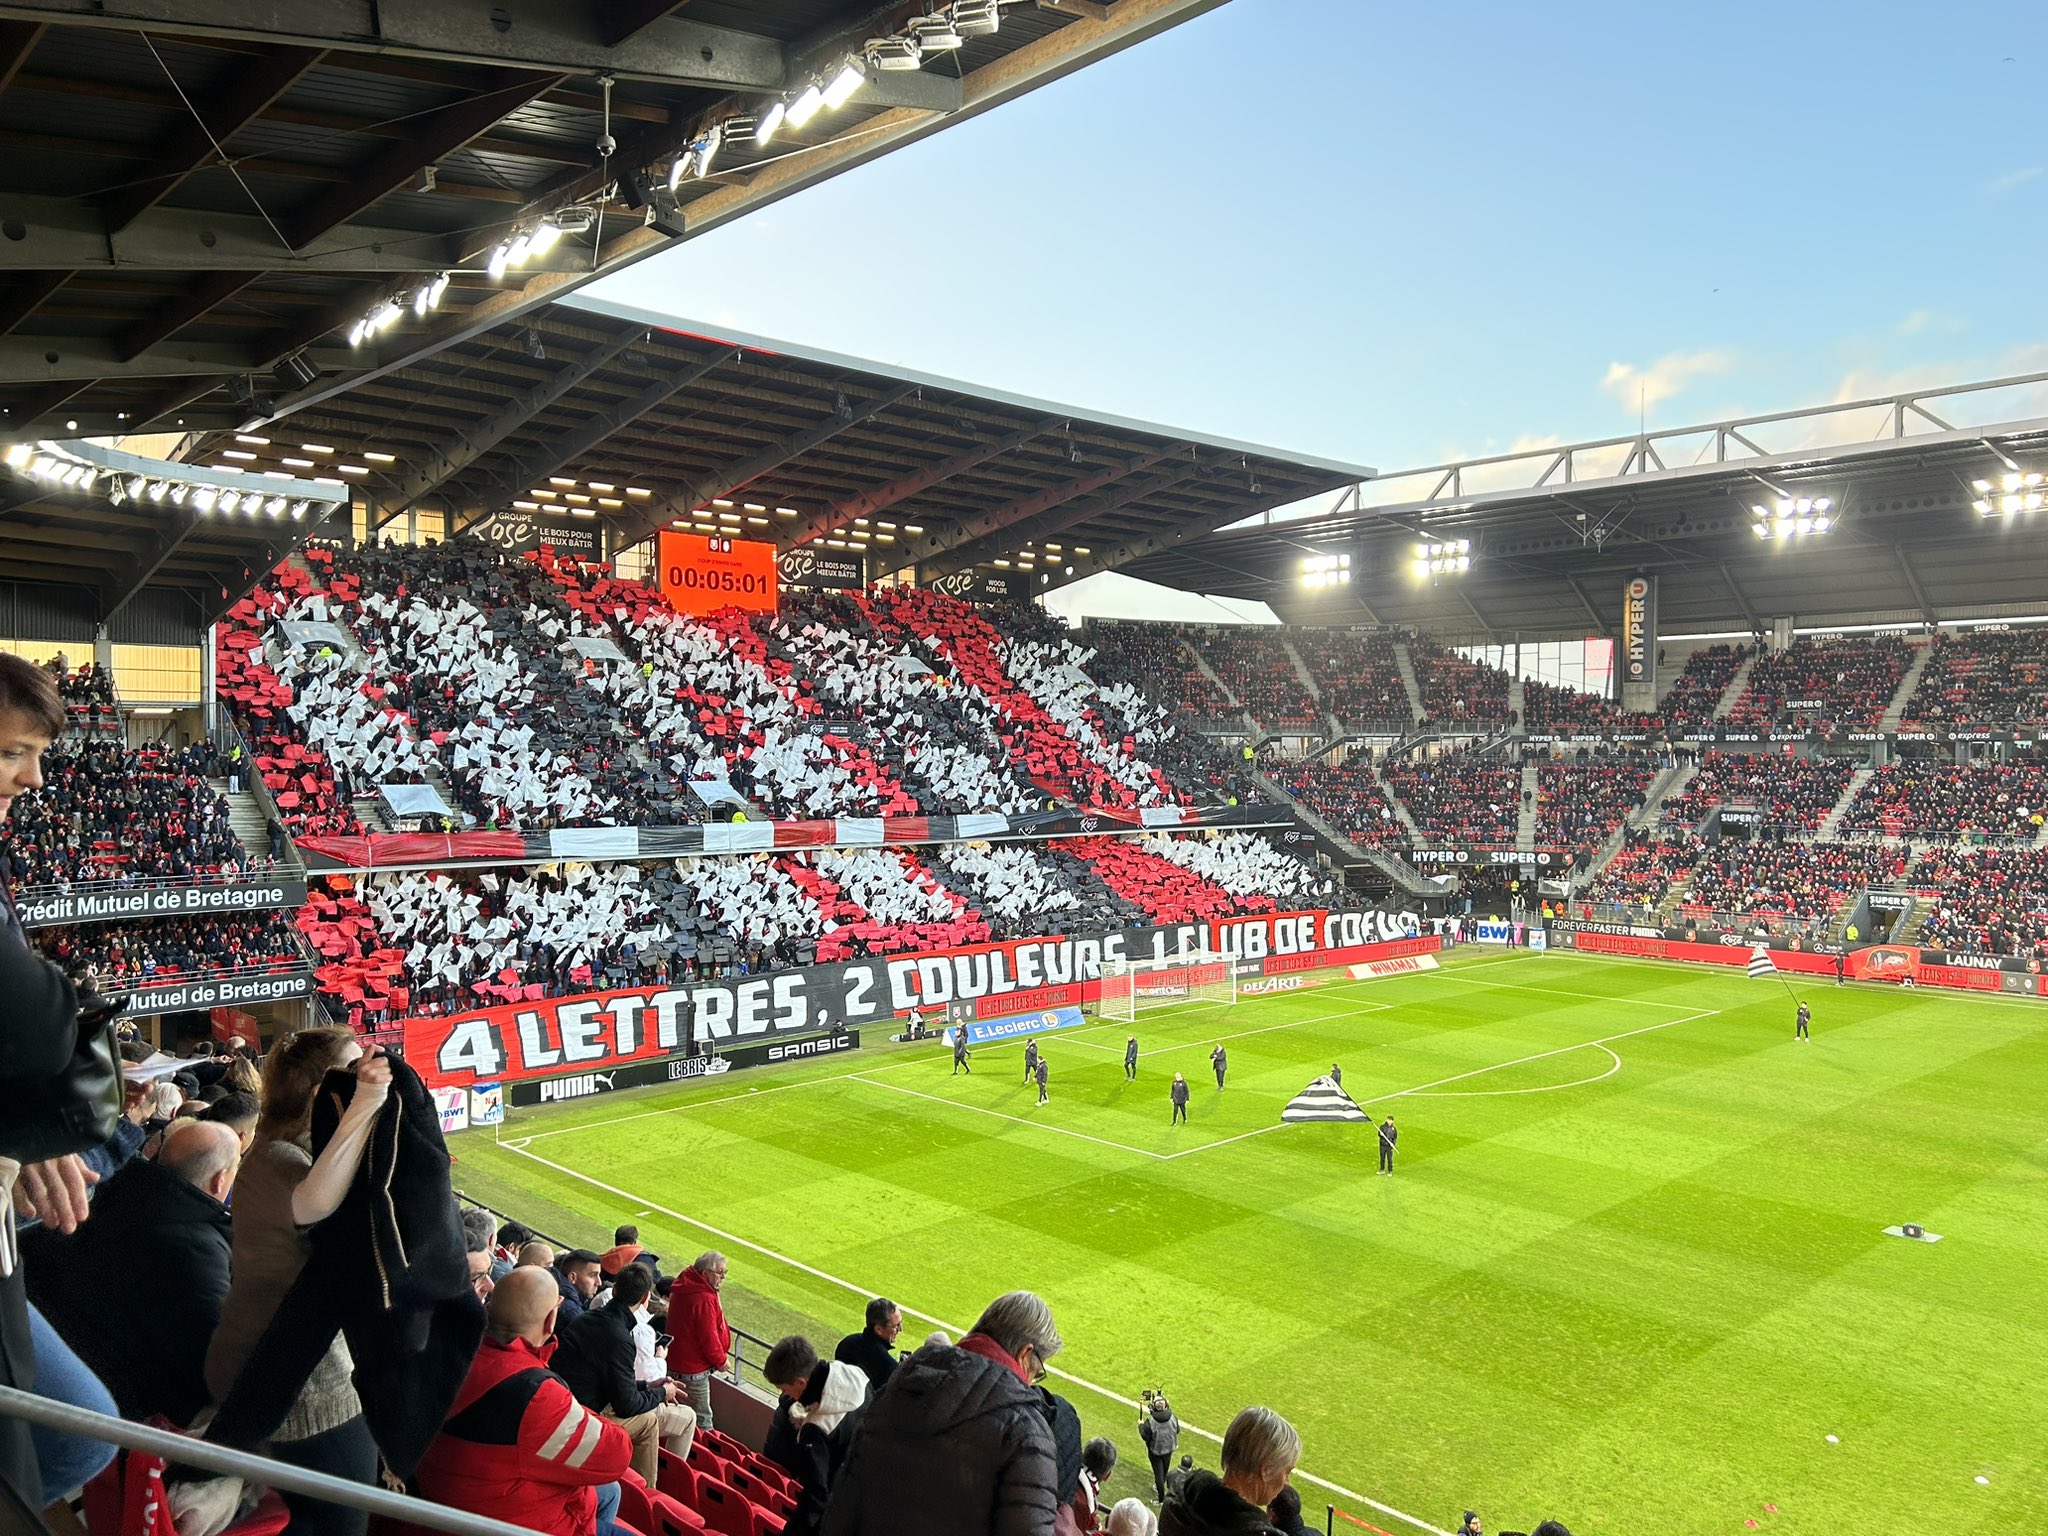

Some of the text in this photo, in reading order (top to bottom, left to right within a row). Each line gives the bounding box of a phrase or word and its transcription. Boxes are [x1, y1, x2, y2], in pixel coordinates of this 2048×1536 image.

[498, 512, 532, 523] GROUPE
[540, 528, 593, 540] LE BOIS POUR
[540, 536, 593, 548] MIEUX BÂTIR
[838, 569, 856, 578] BÂTIR
[840, 563, 856, 571] POUR
[669, 566, 767, 594] 00:05:01
[988, 579, 1005, 587] WOOD
[1630, 600, 1644, 659] HYPER
[1786, 700, 1814, 708] SUPER
[1958, 732, 1990, 740] express
[1721, 814, 1752, 822] SUPER
[1080, 817, 1098, 834] Rose
[1413, 852, 1454, 862] HYPER
[1491, 852, 1536, 863] SUPER
[16, 887, 284, 922] Crédit Mutuel de Bretagne
[1870, 896, 1900, 905] SUPER
[1478, 926, 1508, 939] BW
[1719, 934, 1743, 947] Rose
[1368, 958, 1422, 975] WINAMAX
[1946, 954, 2002, 969] LAUNAY
[1923, 969, 1941, 982] EATS
[1964, 970, 1998, 987] JOURNÉE
[1243, 976, 1304, 994] DEL ARTE
[122, 988, 186, 1010] Mutuel
[191, 987, 215, 1004] de
[220, 978, 306, 1000] Bretagne
[440, 1021, 500, 1074] 4
[842, 966, 876, 1016] 2
[888, 934, 1126, 1010] COULEURS
[1152, 931, 1168, 970] 1
[1178, 920, 1268, 966] CLUB
[1274, 915, 1316, 955] DE
[981, 1001, 997, 1015] LIGUE
[1001, 998, 1016, 1013] UBER
[1017, 995, 1030, 1010] EATS
[1046, 988, 1069, 1006] JOURNÉE
[974, 1019, 1040, 1039] E.Leclerc
[768, 1035, 849, 1060] SAMSIC
[668, 1057, 707, 1080] LE BRIS
[444, 1108, 464, 1118] BWT
